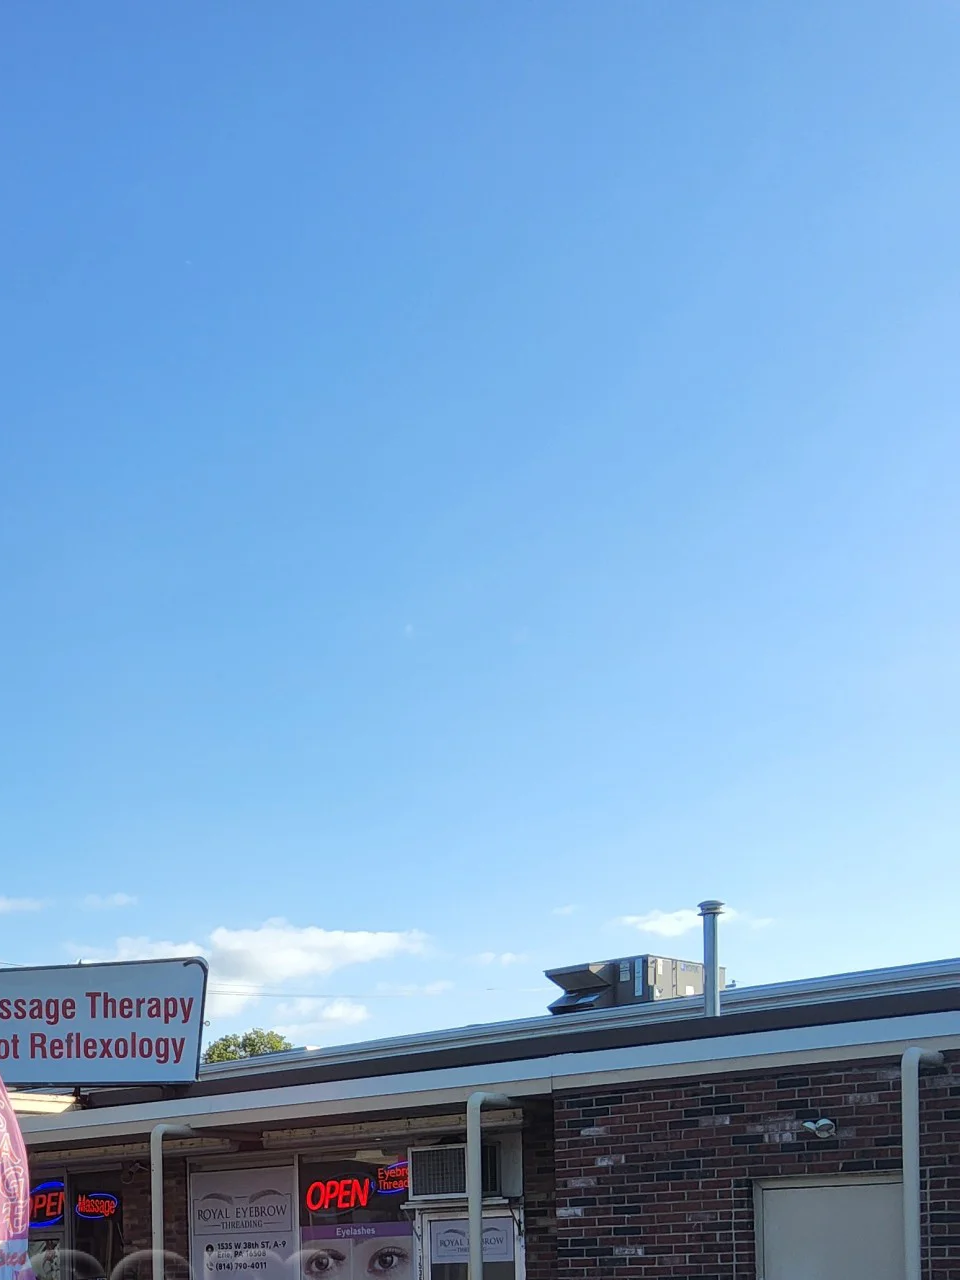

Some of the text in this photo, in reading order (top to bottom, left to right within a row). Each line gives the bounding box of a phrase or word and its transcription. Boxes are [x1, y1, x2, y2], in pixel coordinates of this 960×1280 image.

[85, 991, 194, 1025] Therapy
[29, 1031, 187, 1065] Reflexology
[306, 1178, 370, 1211] OPEN
[77, 1194, 116, 1217] Massage
[197, 1204, 287, 1222] ROYAL EYEBROW
[221, 1220, 263, 1230] THREADING
[336, 1227, 376, 1238] Eyelashes
[217, 1242, 233, 1250] 1535
[234, 1242, 242, 1250] W
[243, 1241, 259, 1249] 38th
[273, 1240, 287, 1248] A-9
[439, 1239, 464, 1248] ROYAL
[234, 1250, 242, 1258] PA
[215, 1261, 267, 1271] (814) 790-4011
